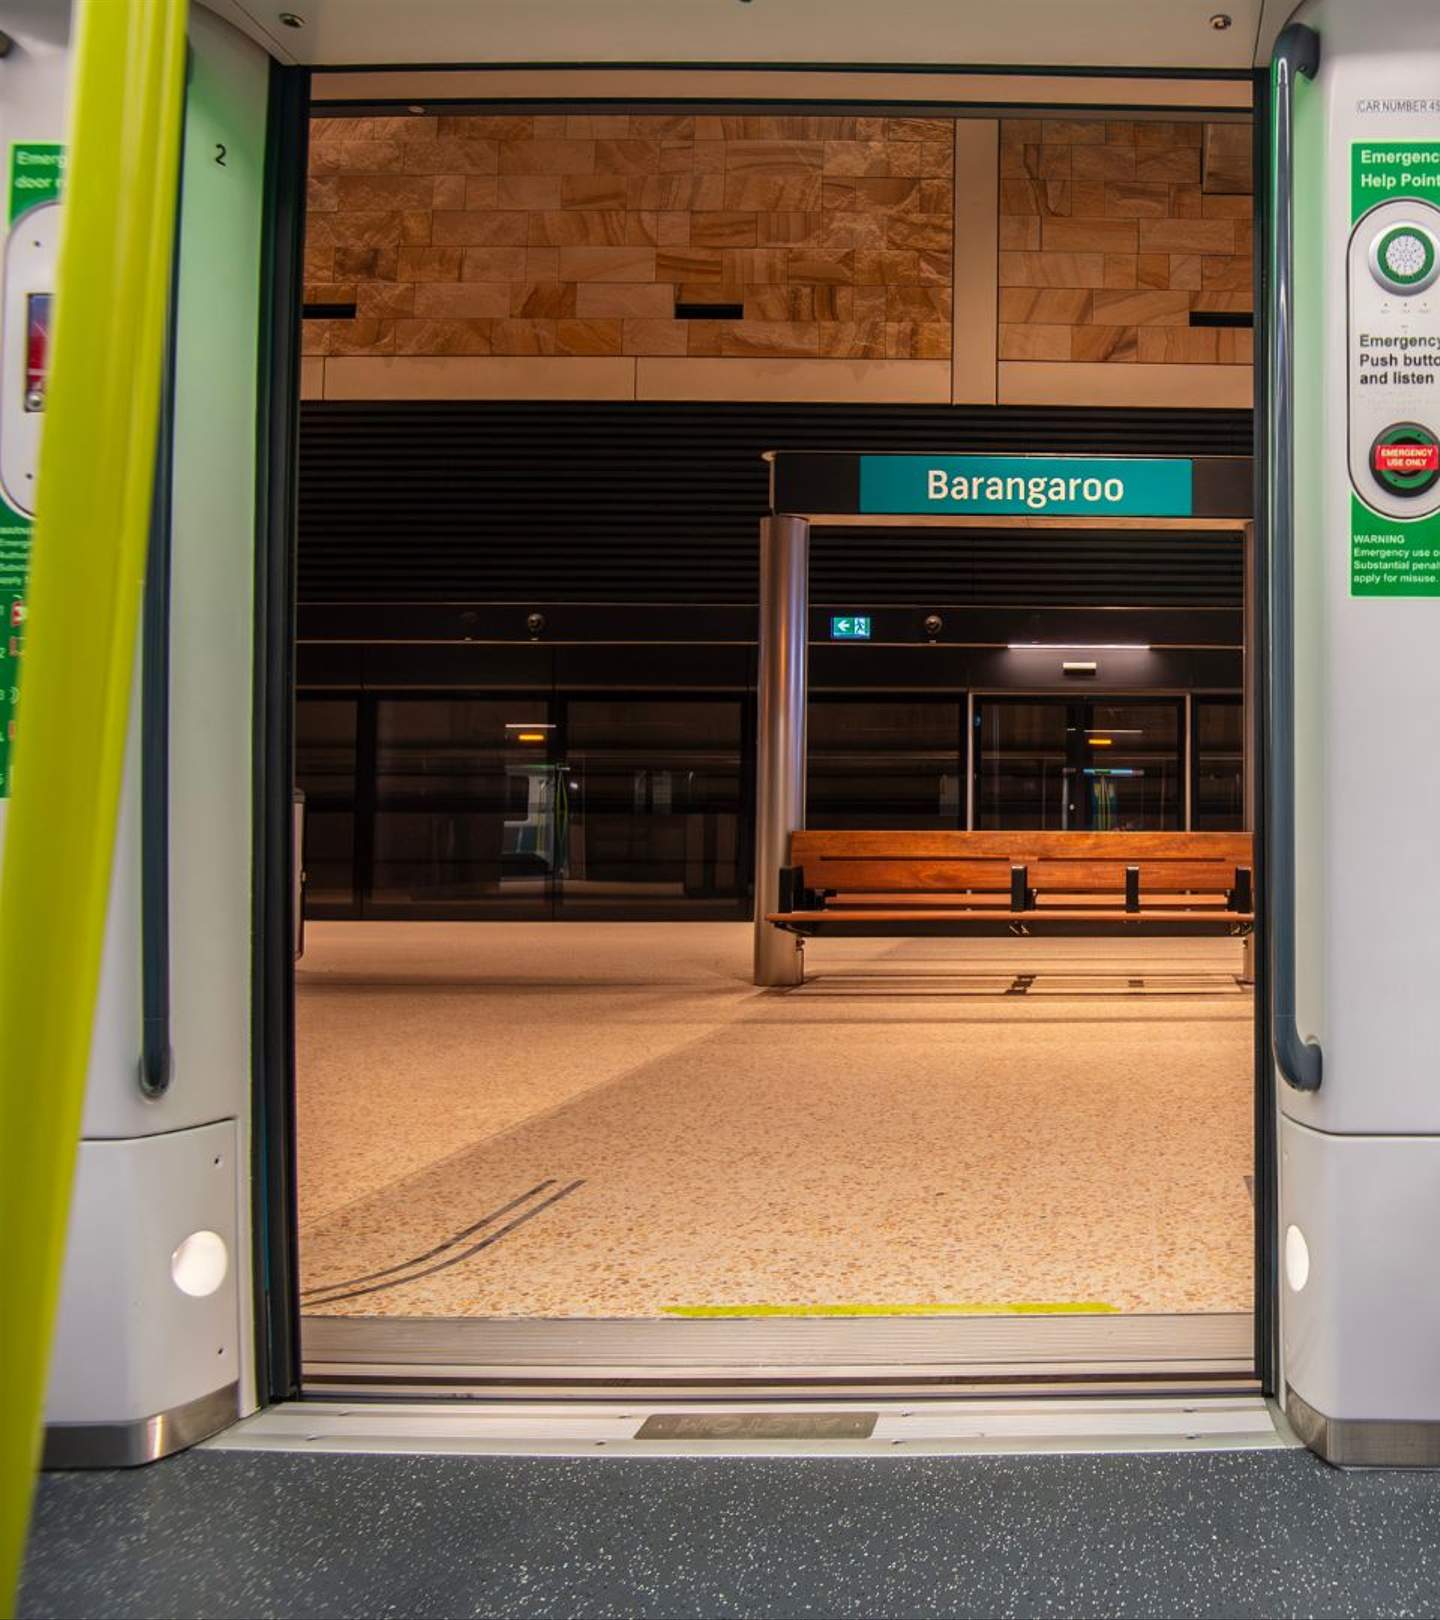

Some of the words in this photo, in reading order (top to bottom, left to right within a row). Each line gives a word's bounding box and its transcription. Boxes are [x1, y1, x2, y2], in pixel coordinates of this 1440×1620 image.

[1358, 100, 1380, 112] CAR
[1382, 100, 1427, 112] NUMBER
[16, 151, 67, 168] Emerg
[215, 143, 226, 167] 2
[15, 175, 51, 188] door
[1361, 173, 1397, 190] Help
[1360, 353, 1398, 366] Push
[1360, 371, 1388, 384] and
[1393, 371, 1434, 384] listen
[1380, 448, 1433, 457] EMERGENCY
[1387, 459, 1404, 467] USE
[1405, 459, 1427, 467] ONLY
[928, 470, 1124, 509] Barangaroo
[1354, 535, 1405, 544] WARNING
[1354, 548, 1410, 559] Emergency
[1354, 561, 1410, 570] Substantial
[1354, 573, 1380, 584] apply
[1383, 573, 1398, 582] for
[1400, 573, 1439, 582] misuse.
